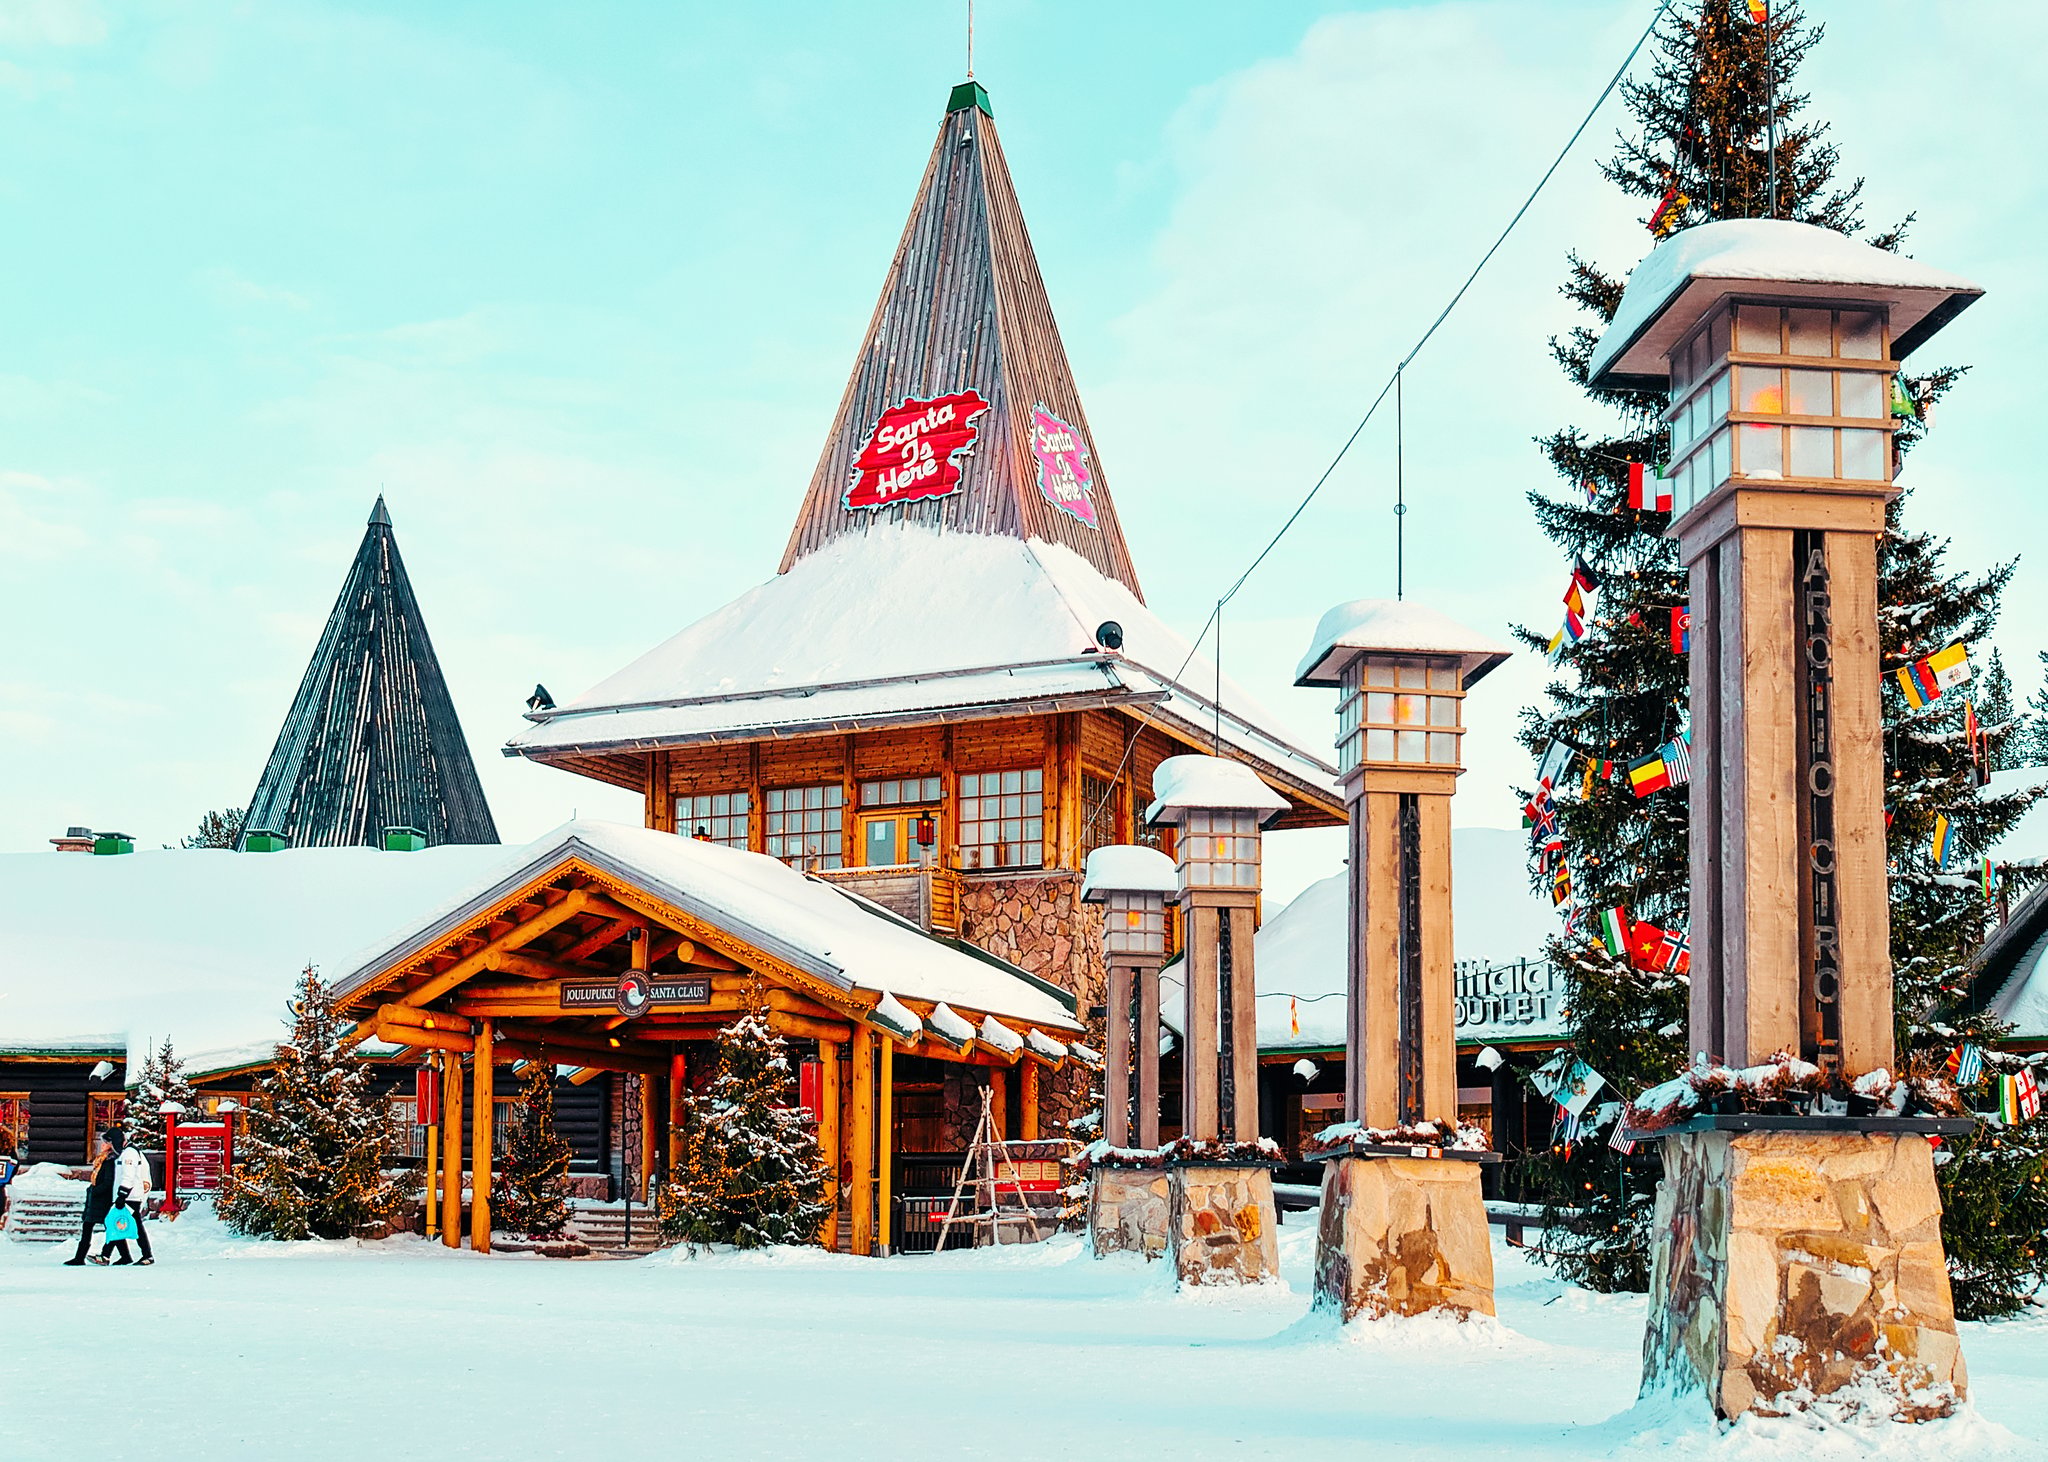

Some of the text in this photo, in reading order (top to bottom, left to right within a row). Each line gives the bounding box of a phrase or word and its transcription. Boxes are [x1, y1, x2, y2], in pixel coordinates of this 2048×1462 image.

[877, 403, 956, 454] Santa
[1038, 425, 1076, 454] Santa
[876, 457, 938, 499] Here
[1051, 474, 1082, 502] Here
[566, 986, 704, 1002] JOULUPUKKI SANTA CLAUS
[1454, 994, 1550, 1027] OUTLET
